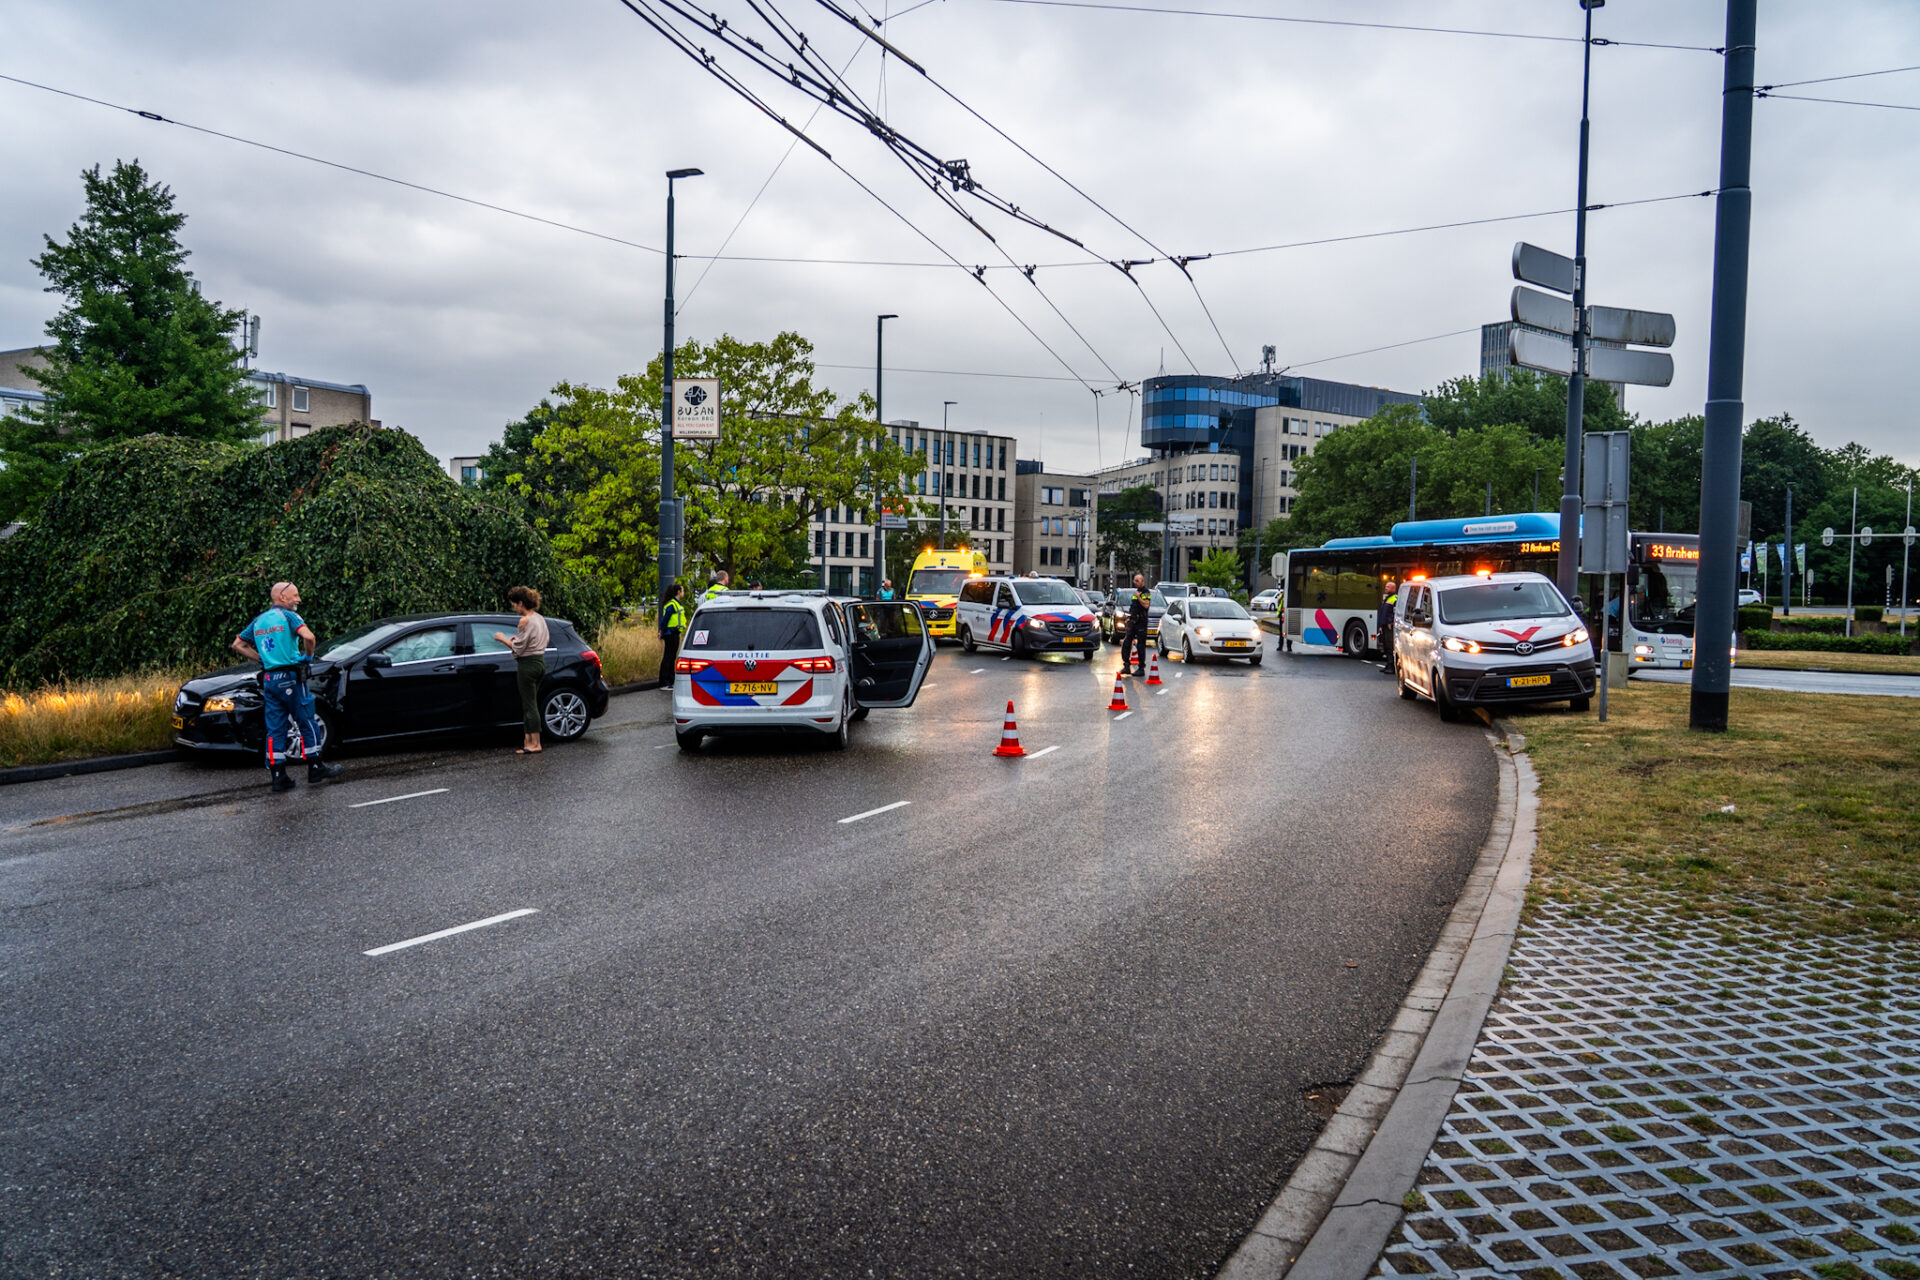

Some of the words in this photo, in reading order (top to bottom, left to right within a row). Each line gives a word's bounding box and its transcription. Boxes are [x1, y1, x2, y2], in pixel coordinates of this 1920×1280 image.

[677, 406, 714, 416] BUSAN
[1521, 542, 1530, 553] 33
[1530, 542, 1551, 552] Arnhem
[1652, 545, 1664, 557] 33
[1666, 547, 1699, 559] Arnhem
[734, 682, 773, 692] Z-716-NV
